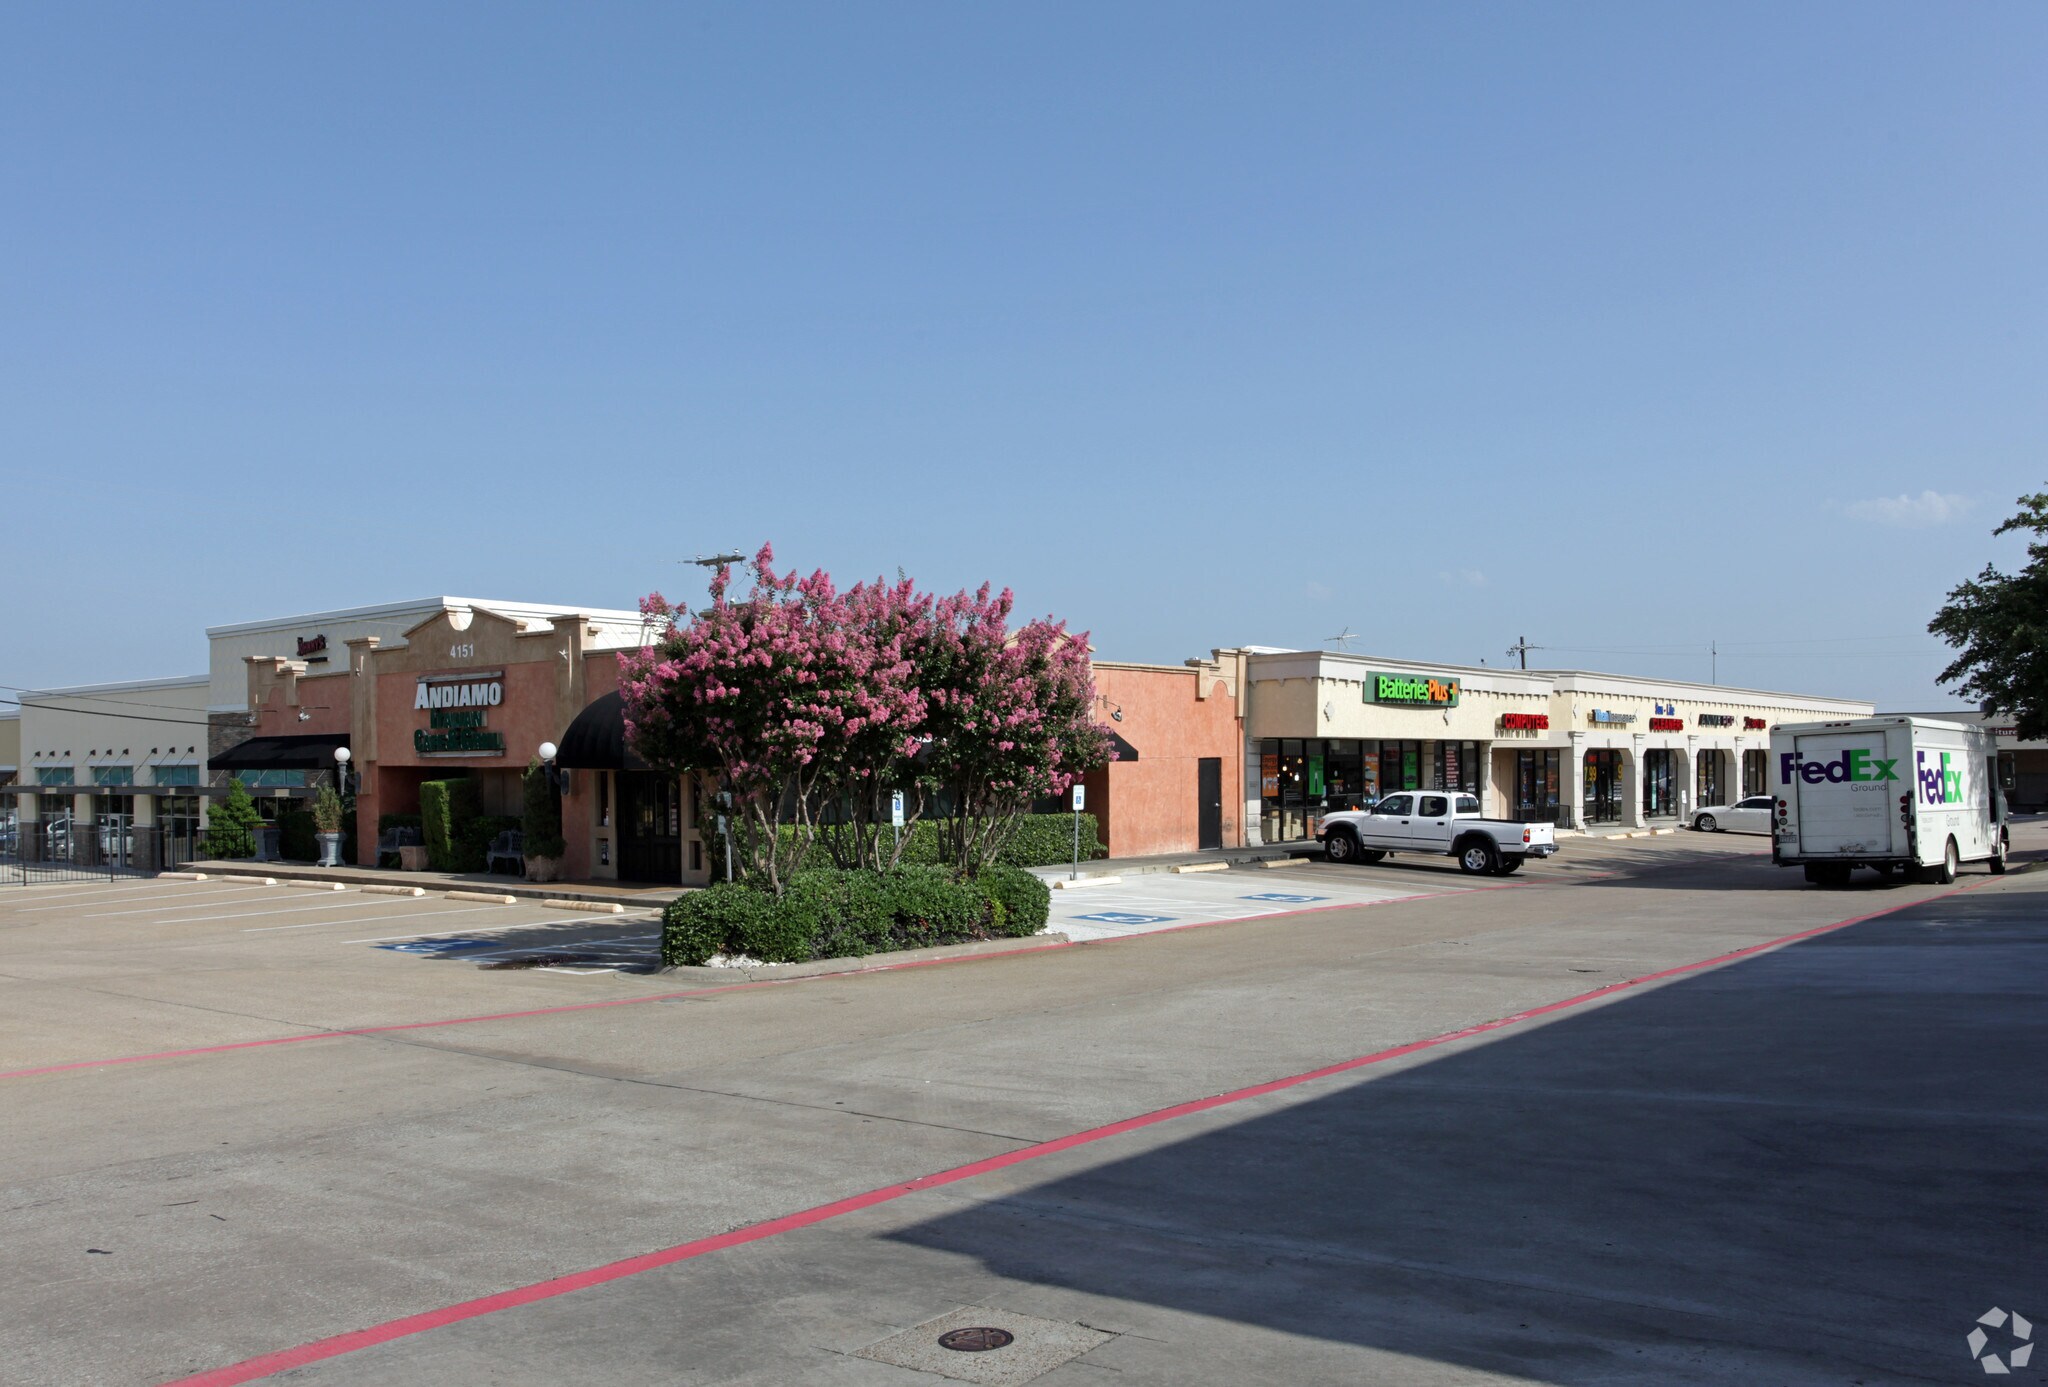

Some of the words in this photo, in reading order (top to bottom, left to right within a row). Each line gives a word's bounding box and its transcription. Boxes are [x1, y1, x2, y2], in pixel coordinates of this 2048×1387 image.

[450, 643, 474, 658] 4151
[414, 682, 502, 709] ANDIAMO
[1505, 713, 1549, 730] COMPUTERS
[1650, 718, 1683, 731] CLEANERS
[1780, 749, 1900, 785] FedEx
[1917, 751, 1963, 805] FedEx
[1850, 783, 1887, 793] Ground
